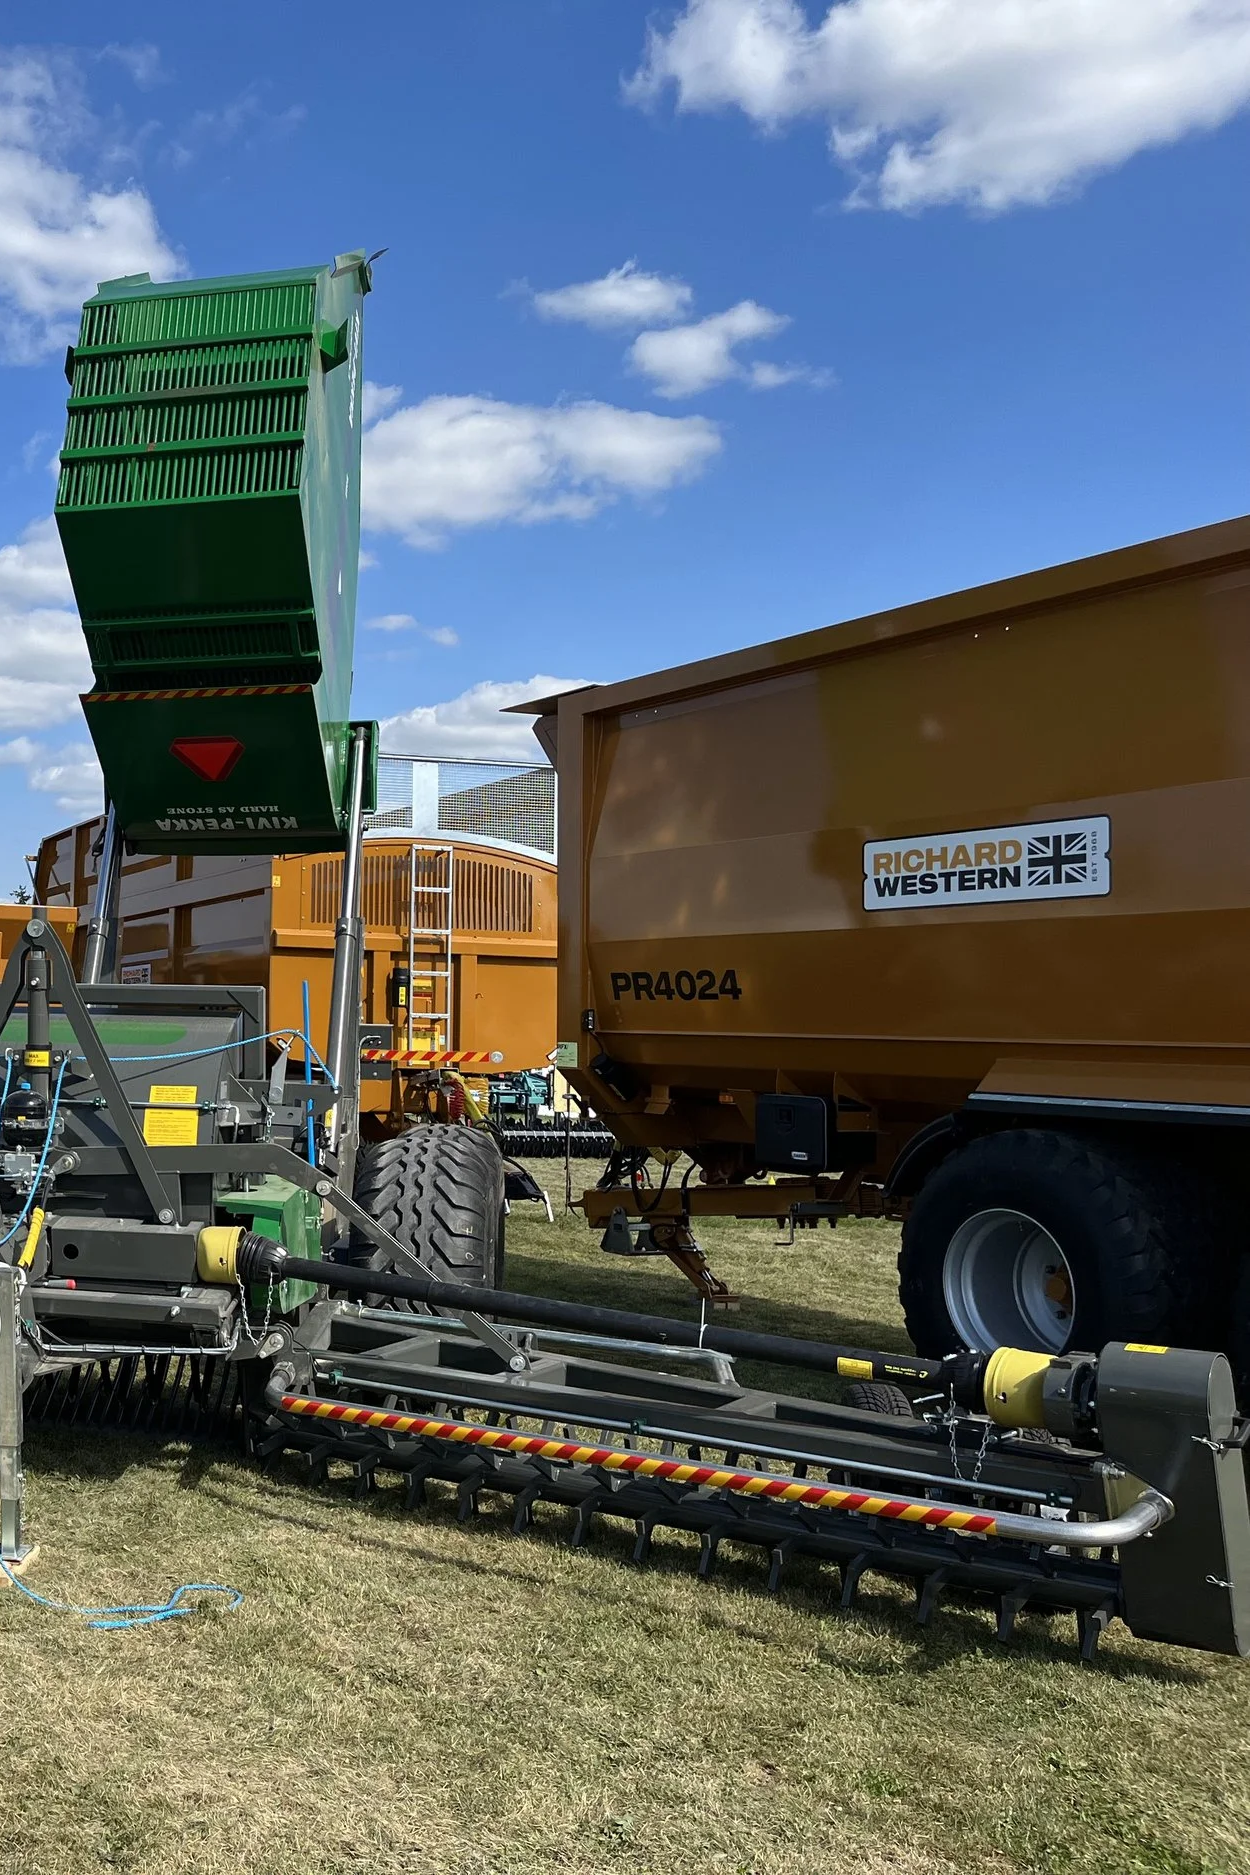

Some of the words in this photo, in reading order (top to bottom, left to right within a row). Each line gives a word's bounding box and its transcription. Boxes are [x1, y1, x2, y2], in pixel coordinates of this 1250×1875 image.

[166, 806, 214, 815] STONE
[239, 805, 280, 813] HARD
[154, 816, 299, 832] KIVI-PEKKA
[873, 839, 1023, 876] RICHARD
[873, 865, 1021, 897] WESTERN
[610, 969, 743, 1001] PR4024
